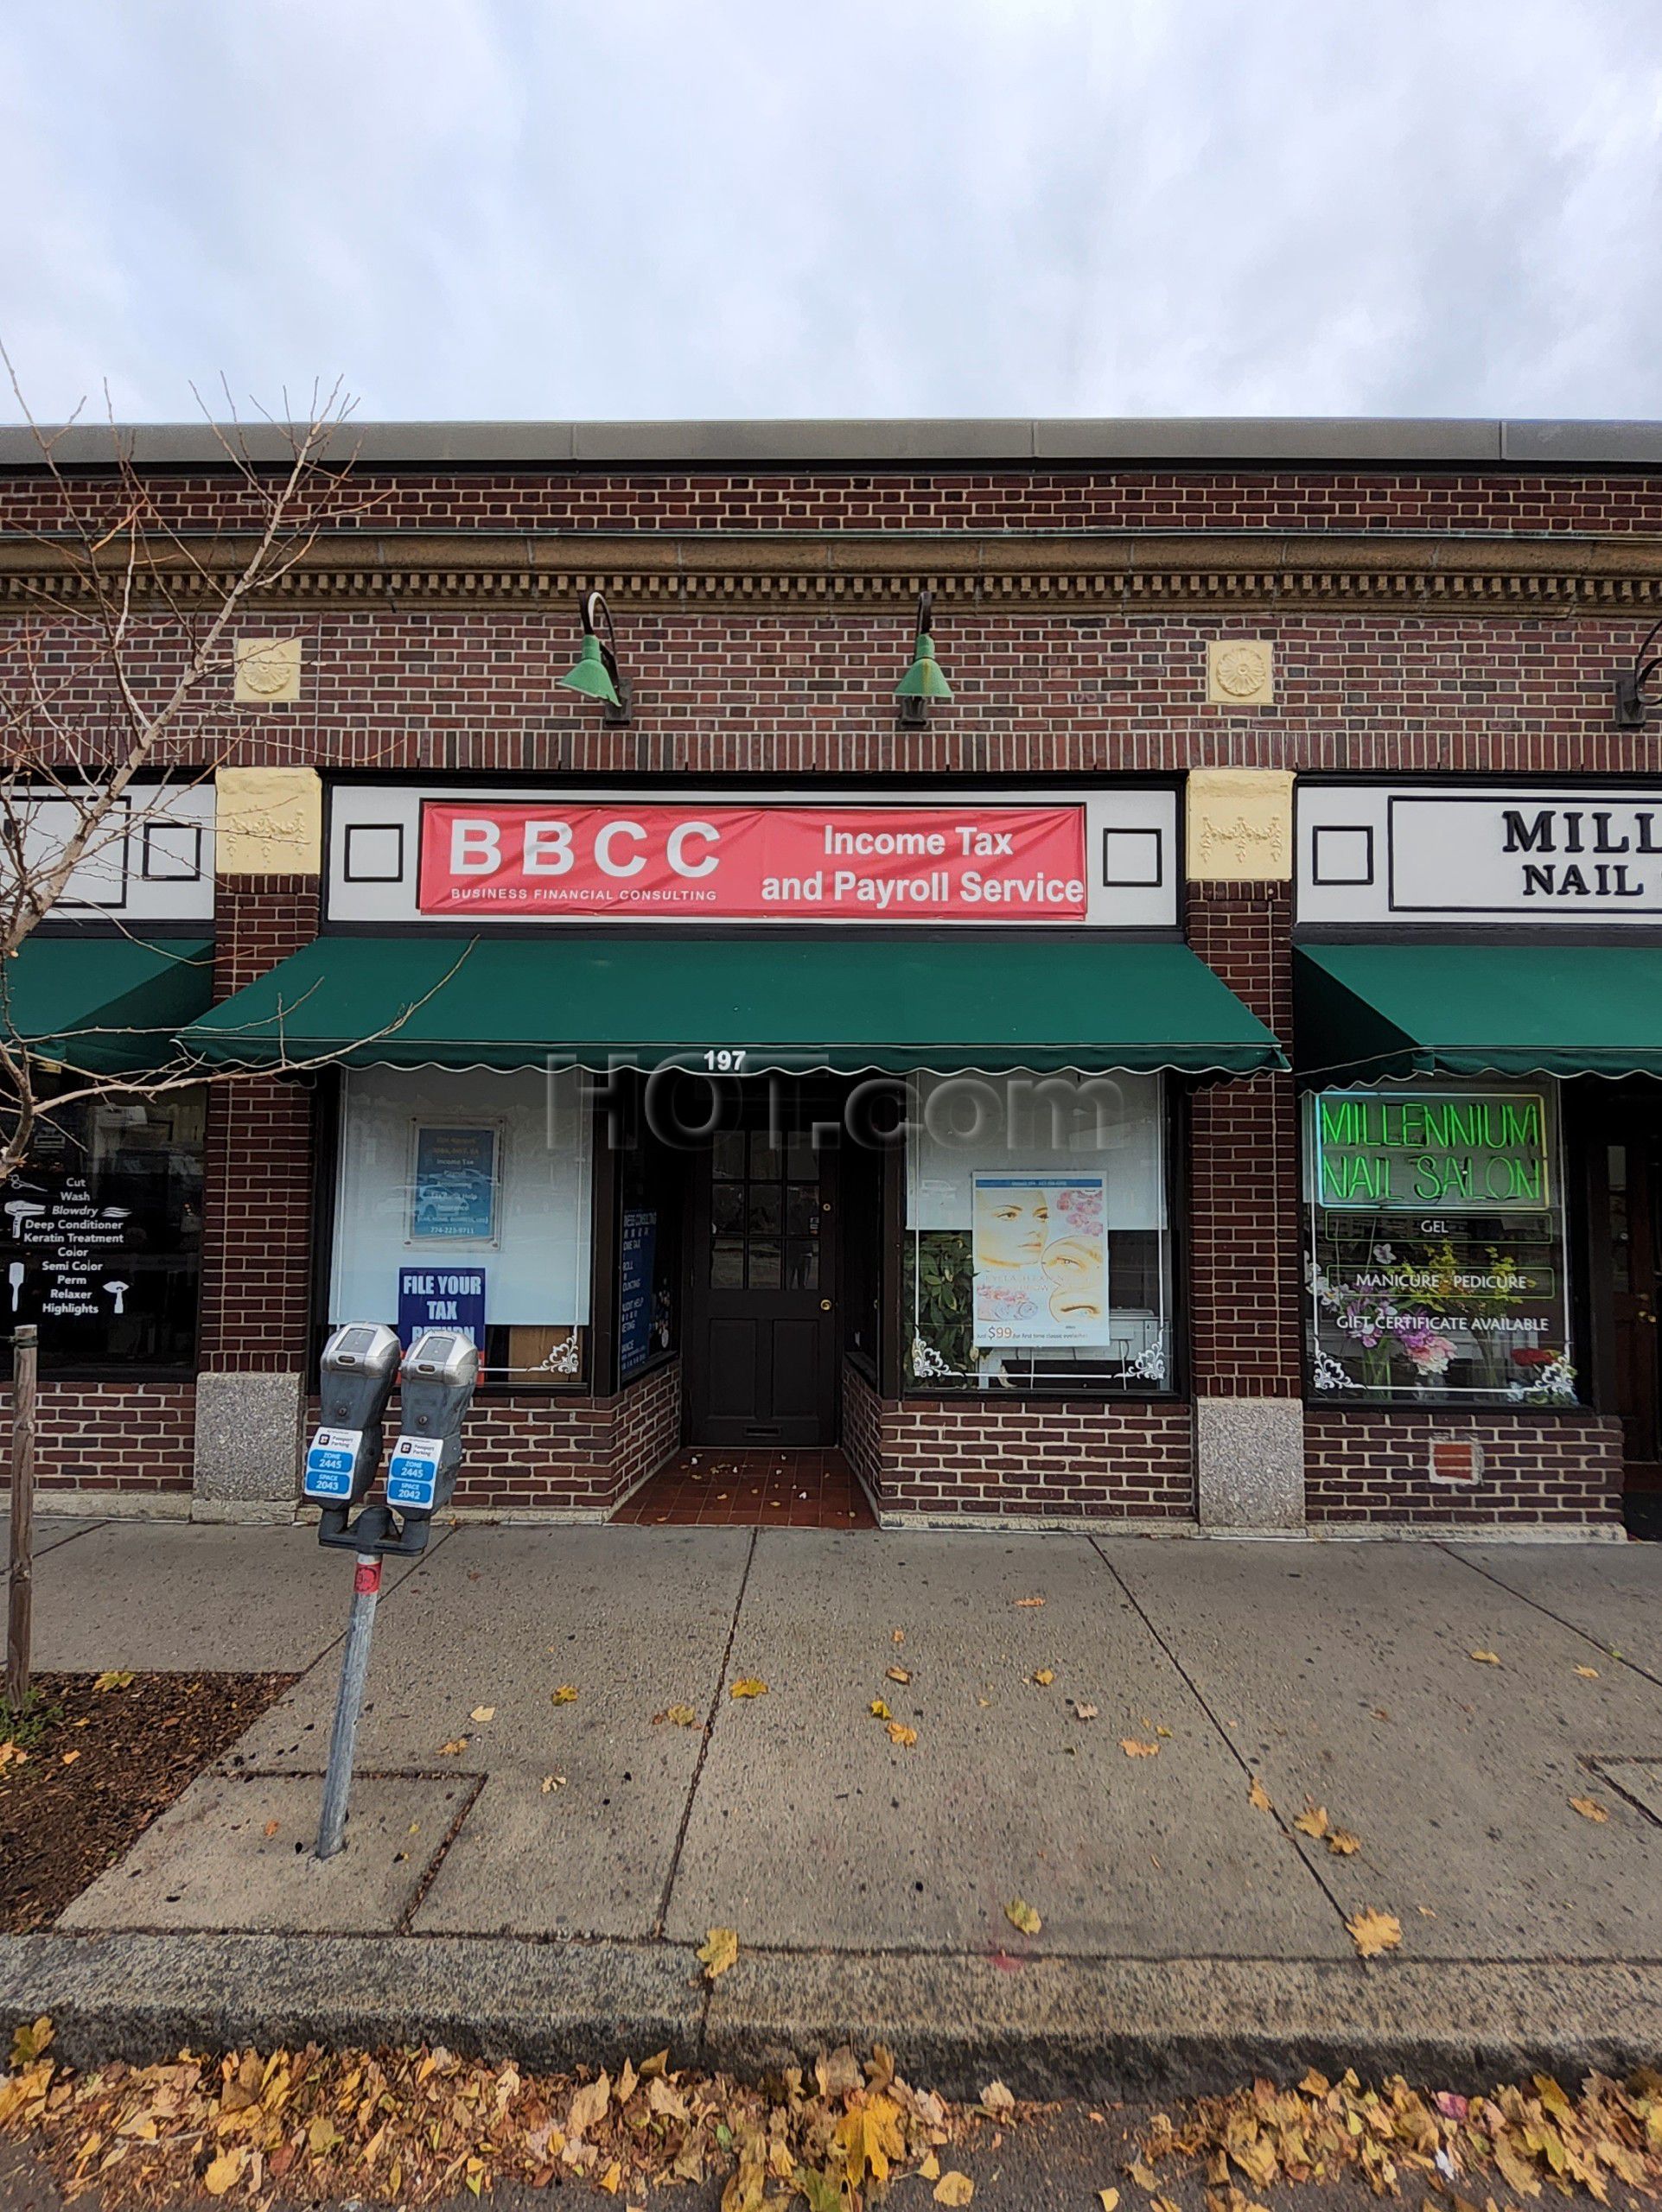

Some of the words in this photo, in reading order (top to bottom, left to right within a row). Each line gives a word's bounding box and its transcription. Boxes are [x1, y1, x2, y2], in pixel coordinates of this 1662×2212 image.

[824, 825, 946, 855] Income
[955, 827, 1013, 855] Tax
[449, 819, 721, 878] BBCC
[1522, 864, 1644, 896] NAIL
[451, 888, 528, 899] BUSINESS
[533, 889, 614, 900] FINANCIAL
[619, 890, 717, 901] CONSULTING
[761, 871, 822, 900] and
[834, 872, 949, 909] Payroll
[959, 872, 1084, 902] Service
[703, 1050, 747, 1071] 197
[1321, 1102, 1538, 1148] MILLENNIUM
[66, 1177, 86, 1187] Cut
[1322, 1155, 1404, 1200] NAIL
[1414, 1155, 1540, 1201] SALON
[60, 1192, 91, 1201] Wash
[52, 1205, 99, 1218] Blowdry
[24, 1219, 54, 1231] Deep
[57, 1219, 124, 1230] Conditioner
[1420, 1220, 1449, 1234] GEL
[23, 1232, 65, 1243] Keratin
[67, 1233, 124, 1243] Treatment
[57, 1244, 89, 1257] Color
[41, 1261, 69, 1271] Semi
[72, 1259, 104, 1272] Color
[57, 1274, 87, 1285] Perm
[403, 1275, 435, 1295] FILE
[437, 1275, 481, 1295] YOUR
[1355, 1274, 1440, 1288] MANICURE
[1453, 1274, 1527, 1290] PEDICURE
[50, 1288, 93, 1299] Relaxer
[41, 1302, 99, 1316] Highlights
[426, 1300, 458, 1320] TAX
[1336, 1315, 1372, 1330] GIFT
[1374, 1316, 1468, 1331] CERTIFICATE
[1471, 1317, 1550, 1332] AVAILABLE
[988, 1325, 1012, 1340] $99
[318, 1459, 342, 1469] 2445
[400, 1467, 423, 1478] 2445
[315, 1480, 339, 1491] 2043
[398, 1489, 421, 1500] 2042
